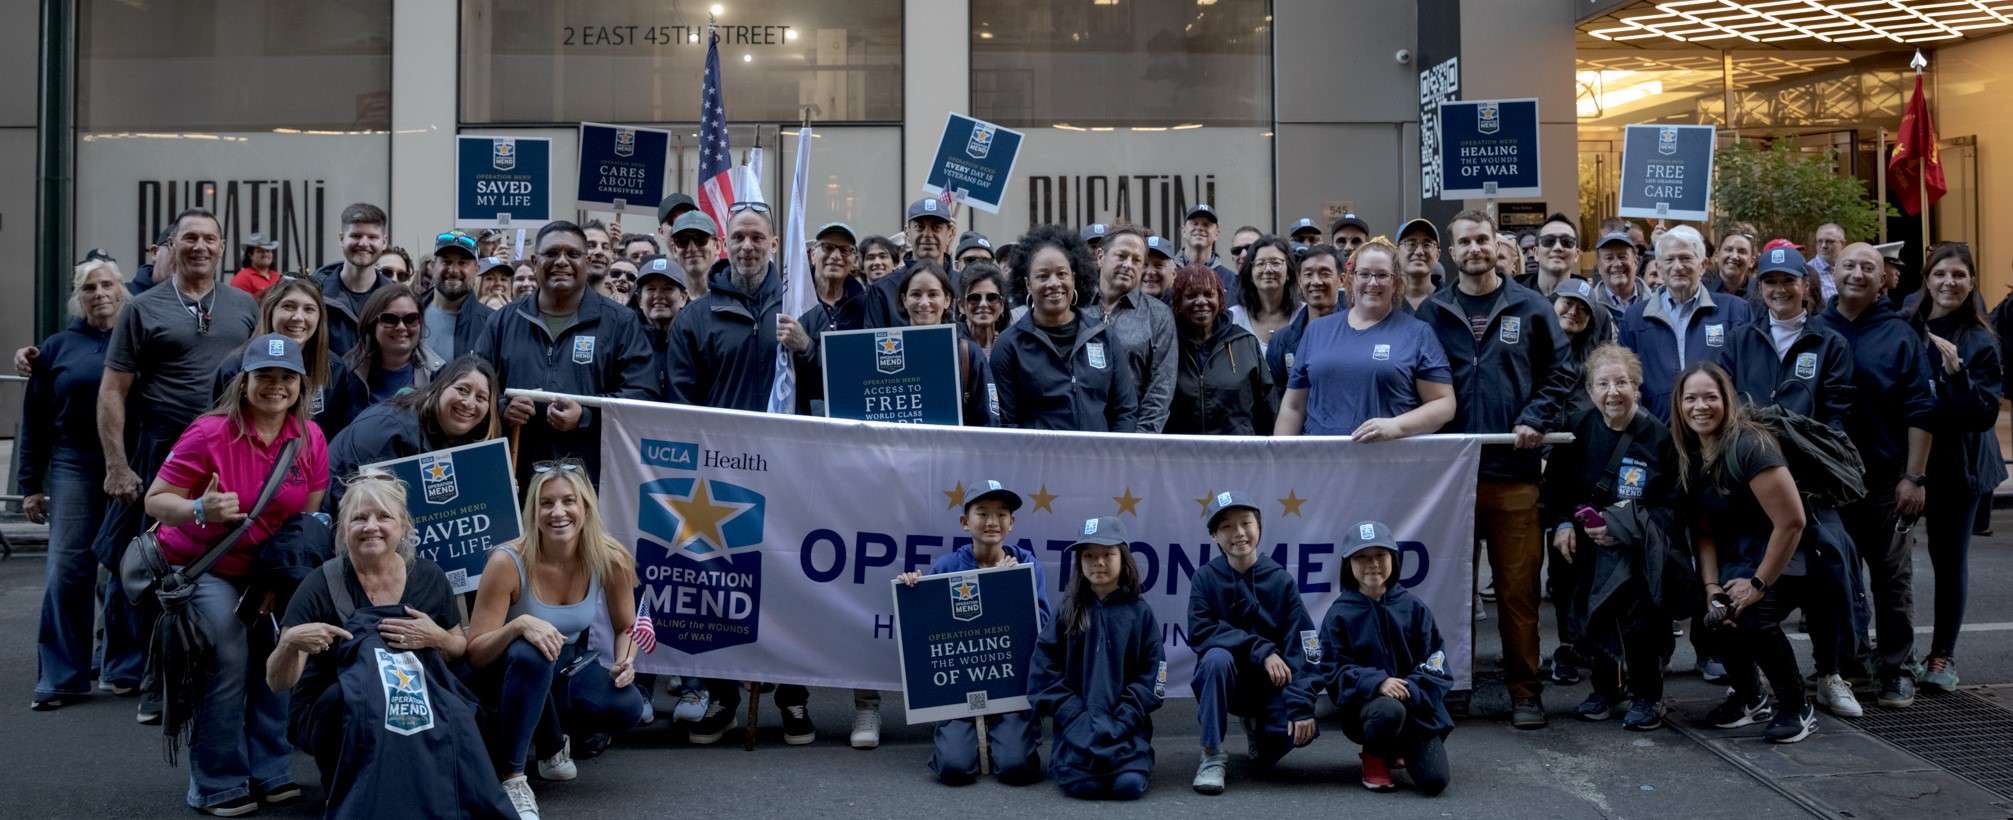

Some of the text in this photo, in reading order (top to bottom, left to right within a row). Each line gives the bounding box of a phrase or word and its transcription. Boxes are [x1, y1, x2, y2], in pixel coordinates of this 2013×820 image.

[563, 27, 575, 46] 2
[583, 26, 638, 46] EAST
[644, 26, 701, 46] 45TH
[1460, 145, 1518, 157] HEALING
[1461, 156, 1518, 165] THE WOUNDS
[599, 165, 646, 178] CARES
[945, 161, 970, 174] EVERY
[970, 168, 986, 177] DAY
[1461, 164, 1519, 177] OF WAR
[1646, 164, 1685, 179] FREE
[599, 176, 645, 189] ABOUT
[943, 168, 992, 188] VETERANS DAY
[476, 180, 532, 194] SAVED
[598, 186, 644, 195] CAREGIVERS
[1644, 184, 1683, 199] CARE
[476, 196, 531, 206] MY LIFE
[864, 384, 922, 395] ACCESS TO
[865, 394, 923, 412] FREE
[865, 410, 923, 421] WORLD CLASS
[648, 446, 768, 471] UCLA Health
[428, 485, 455, 497] MEND
[460, 502, 487, 514] MEND
[408, 514, 491, 547] SAVED
[448, 535, 493, 559] LIFE
[646, 565, 753, 588] OPERATION
[645, 584, 753, 620] MEND
[955, 604, 980, 613] MEND
[689, 620, 705, 630] the
[707, 622, 750, 635] WOUNDS
[928, 625, 1010, 642] OPERATION MEND
[690, 633, 713, 642] WAR
[930, 635, 1012, 658] HEALING
[931, 651, 1013, 669] THE WOUNDS
[933, 663, 1015, 686] OF WAR
[389, 703, 428, 716] MEND
